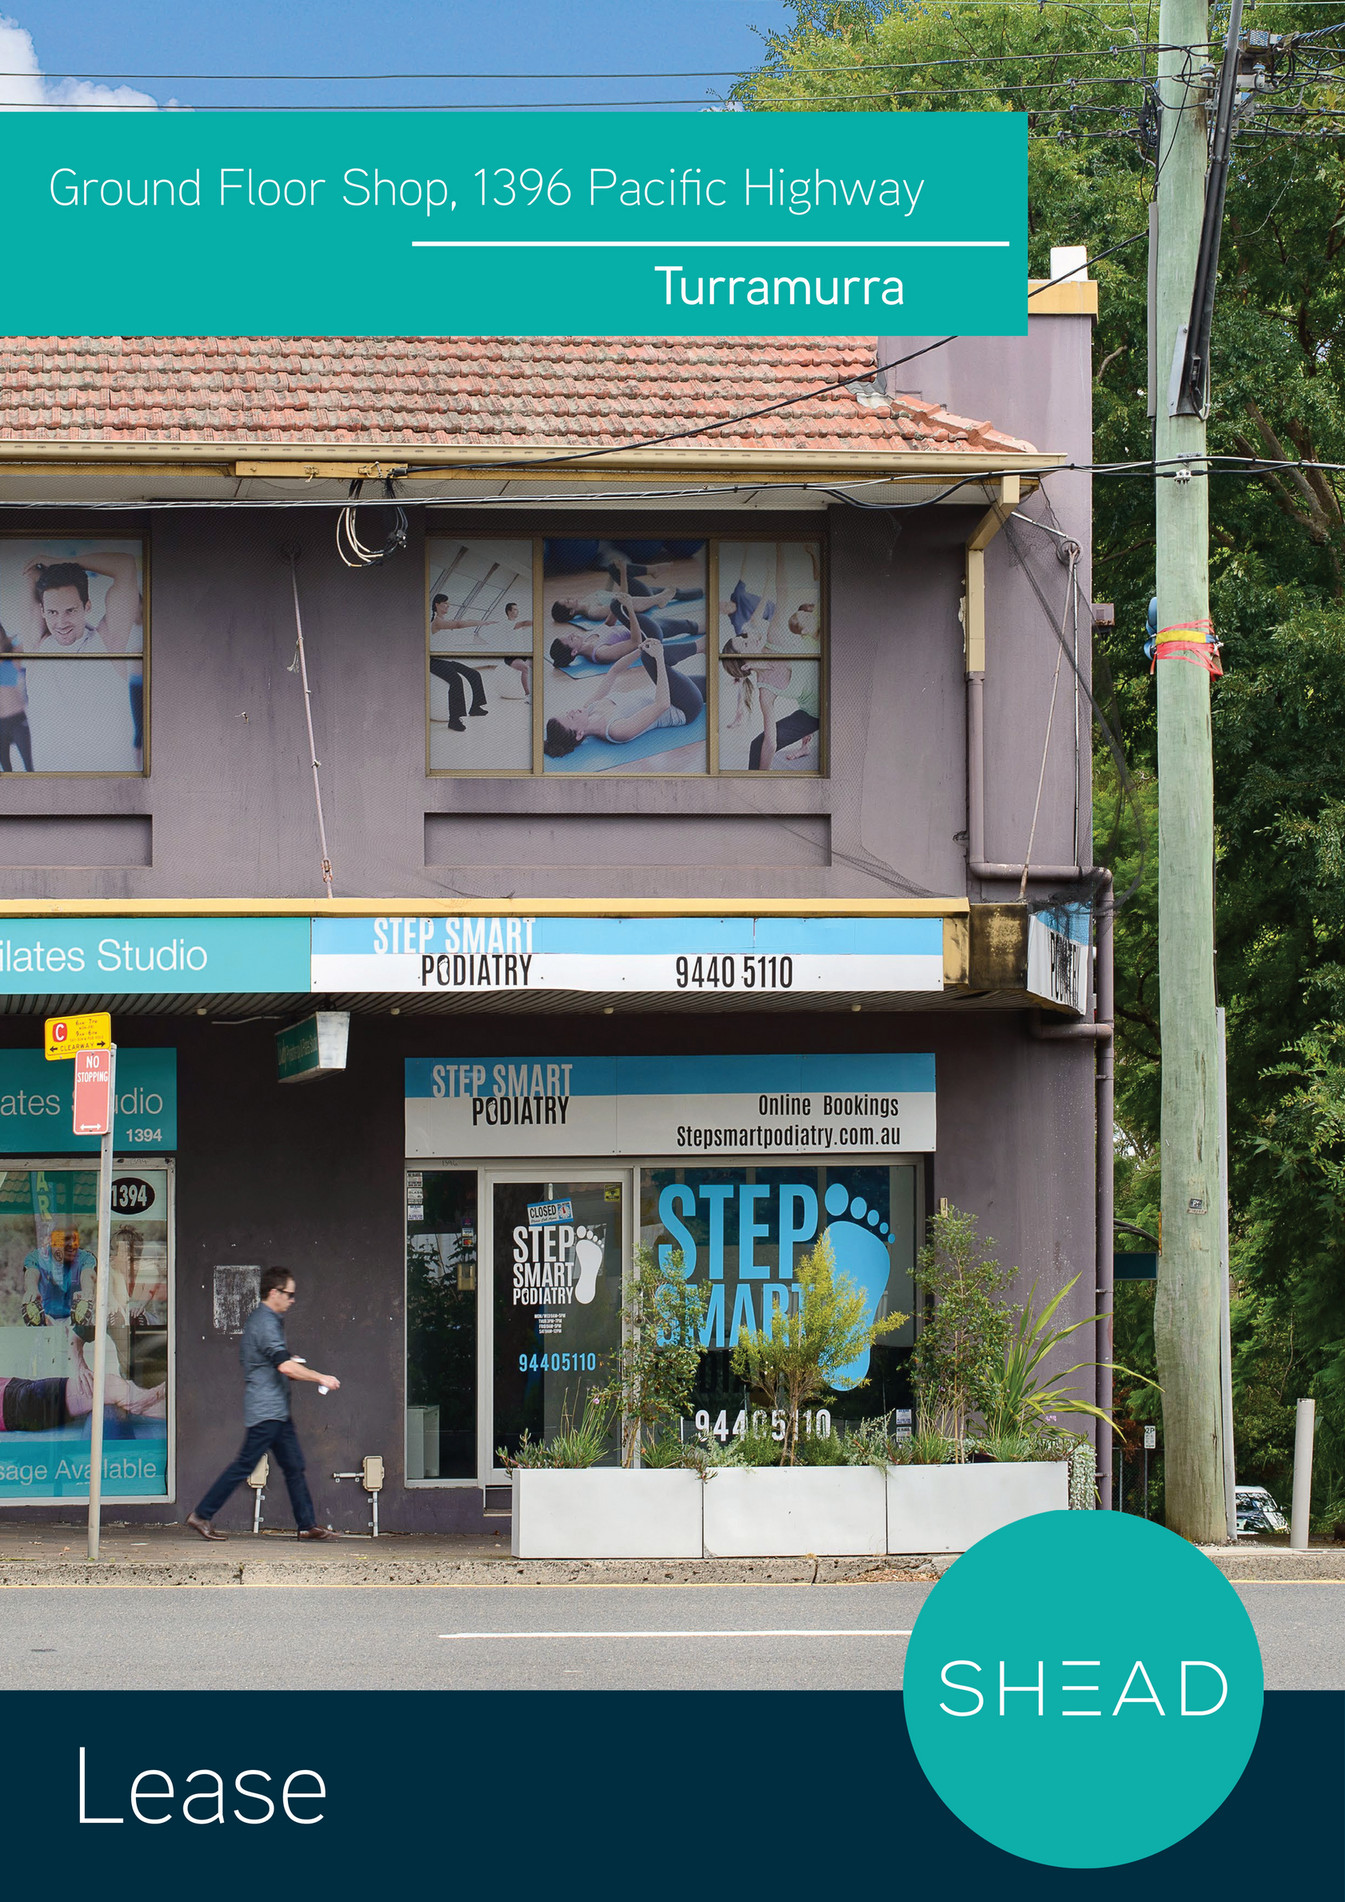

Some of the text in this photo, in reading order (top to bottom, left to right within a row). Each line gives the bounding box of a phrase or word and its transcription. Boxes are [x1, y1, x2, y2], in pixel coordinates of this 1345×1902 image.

[373, 917, 536, 954] STEP SMART
[97, 938, 208, 972] Studio
[421, 954, 533, 987] PODIATRY
[676, 955, 793, 988] 9440 5110
[55, 1023, 65, 1042] C
[60, 1042, 94, 1052] CLEARWAY
[86, 1055, 100, 1069] NO
[77, 1071, 109, 1083] STOPPING
[432, 1063, 573, 1098] STEP SMART
[472, 1095, 570, 1126] PODIATRY
[758, 1094, 899, 1118] Online Bookings
[125, 1128, 163, 1142] 1394
[676, 1124, 901, 1149] Stepsmartpodiatry.com.au
[111, 1184, 148, 1207] 1394
[529, 1204, 557, 1218] CLOSED
[512, 1225, 576, 1263] STEP
[658, 1183, 819, 1281] STEP
[512, 1262, 575, 1288] SMART
[512, 1286, 574, 1305] PODIATRY
[518, 1352, 597, 1372] 94405110
[54, 1458, 157, 1480] Avalable
